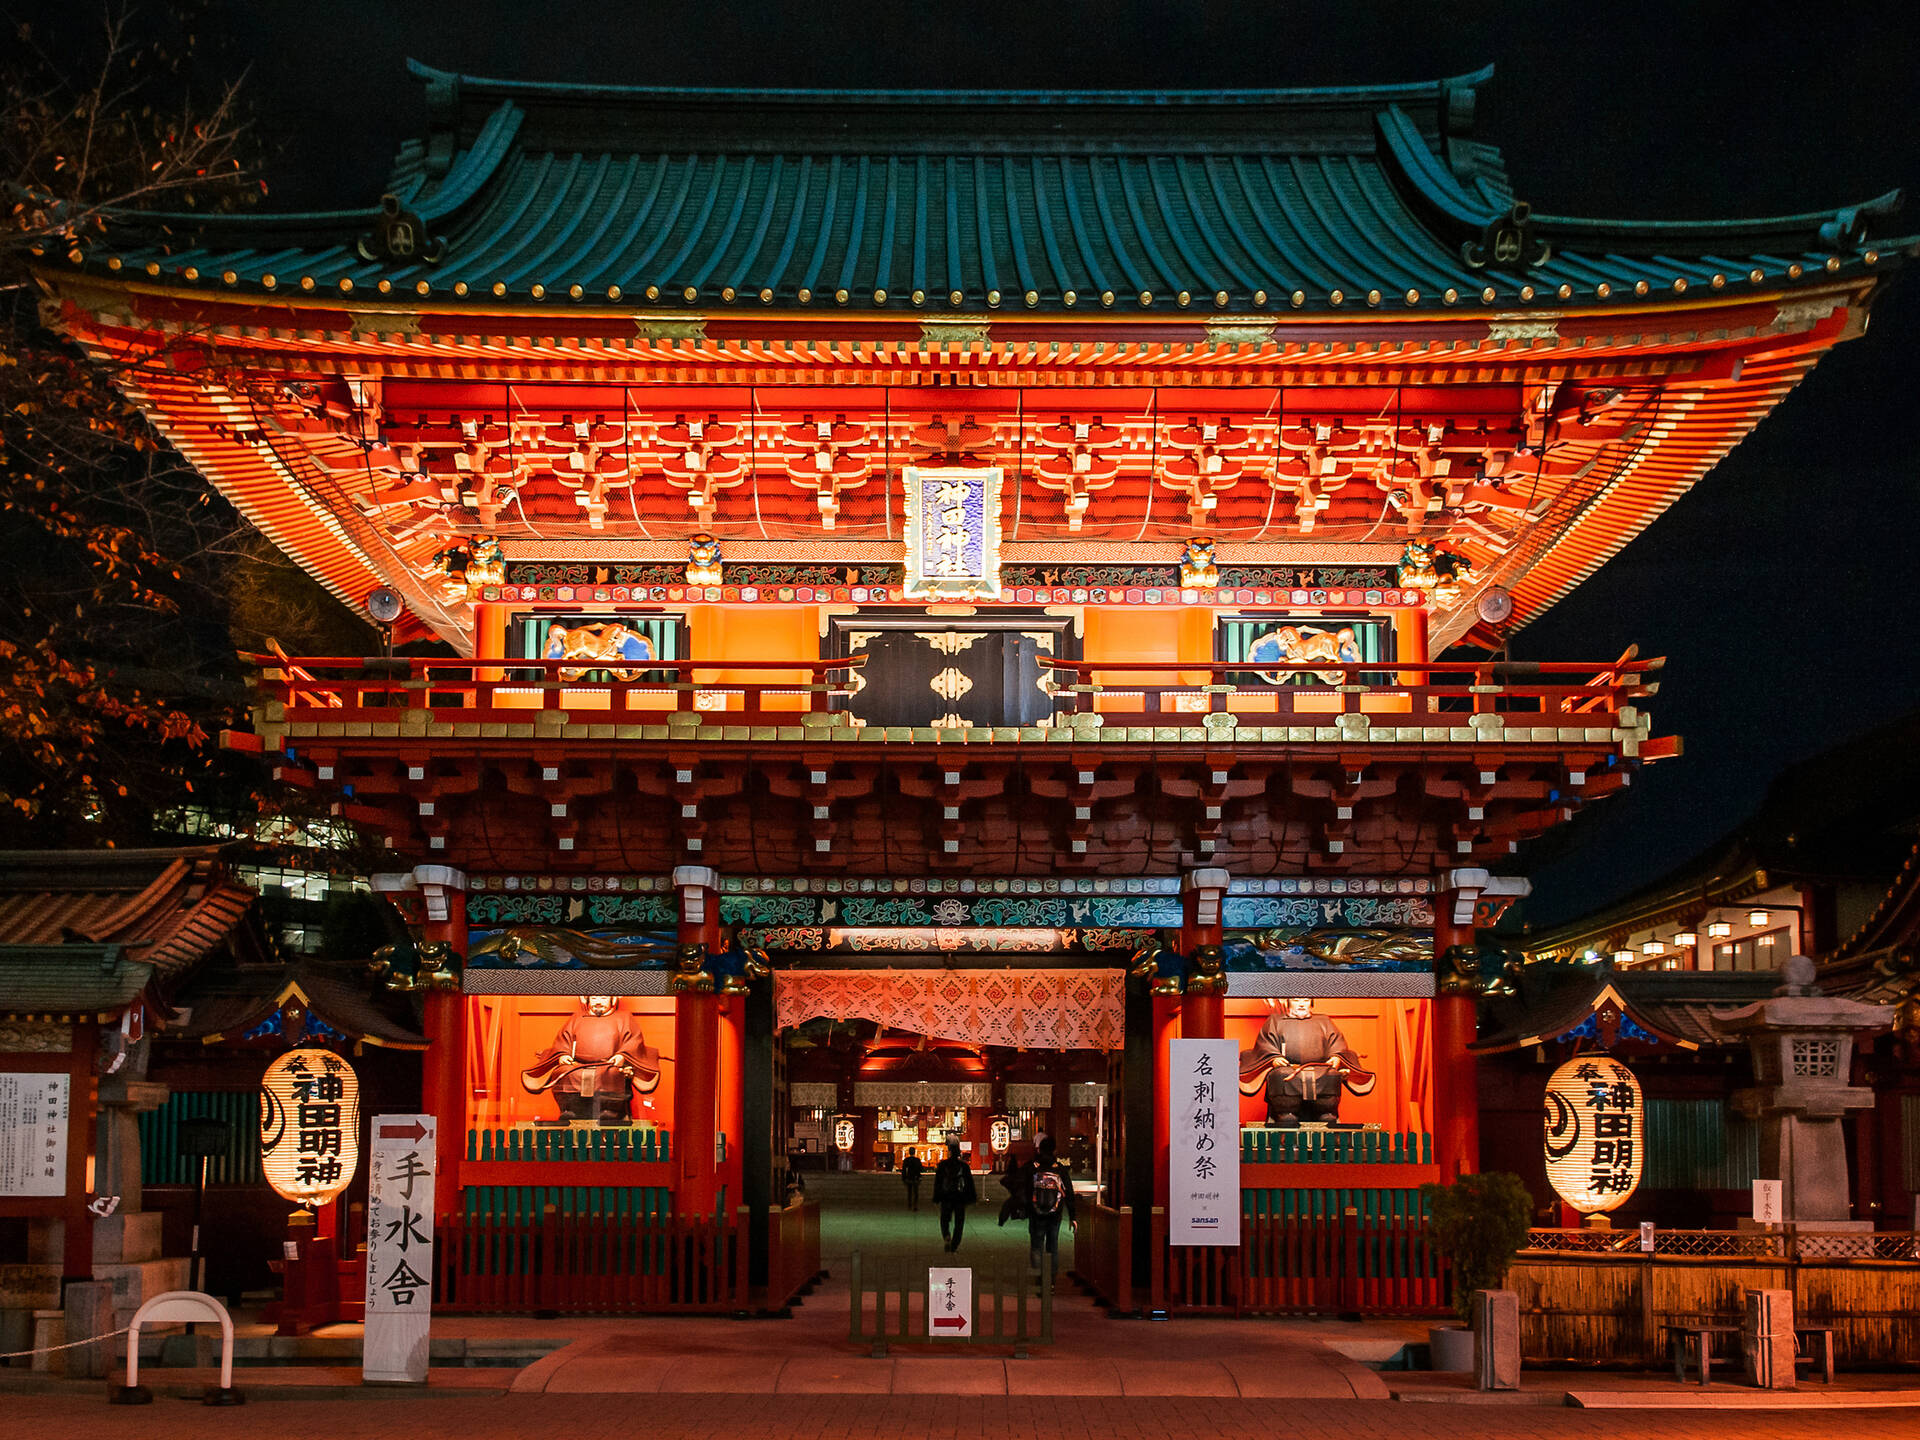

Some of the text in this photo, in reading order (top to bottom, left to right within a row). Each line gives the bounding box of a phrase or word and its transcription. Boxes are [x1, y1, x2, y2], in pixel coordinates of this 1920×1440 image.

[935, 479, 972, 577] 神田神社
[44, 1081, 59, 1177] 神田神社御由緒
[291, 1072, 343, 1186] 神田明神
[1192, 1053, 1217, 1180] 名刺納め祭
[1586, 1080, 1635, 1196] 神田明神
[381, 1150, 432, 1307] 手水舎
[944, 1277, 956, 1312] 手水舎
